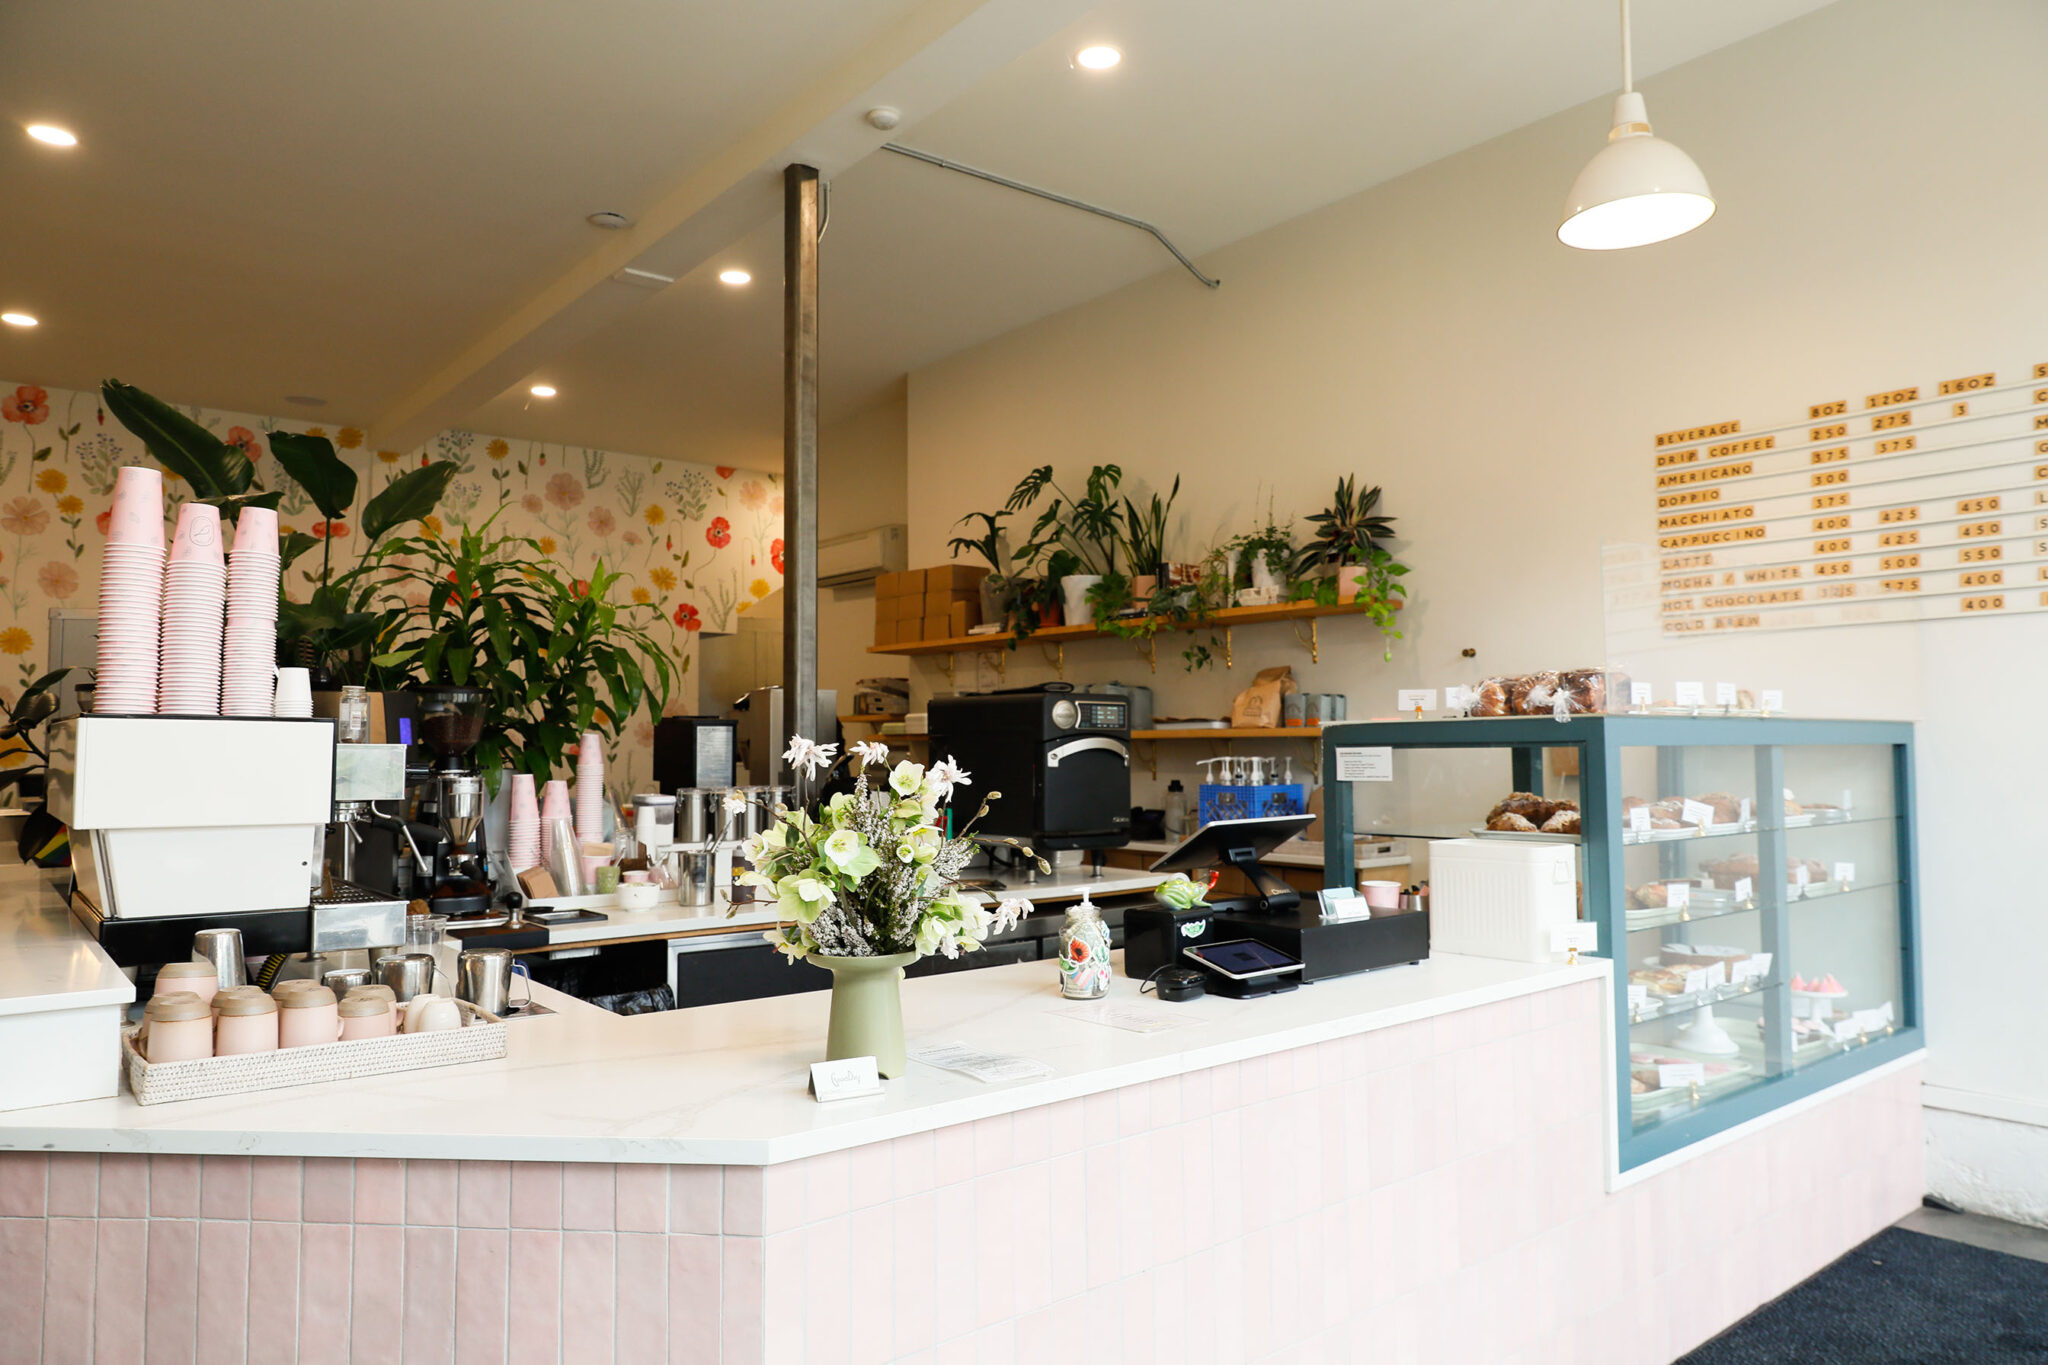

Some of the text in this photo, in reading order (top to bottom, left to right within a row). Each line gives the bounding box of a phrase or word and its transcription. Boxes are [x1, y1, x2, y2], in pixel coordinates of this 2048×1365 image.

[1657, 423, 1738, 446] BEVERAGE
[1870, 389, 1917, 407] 12OZ
[1943, 376, 1993, 394] 16OZ
[1657, 405, 1965, 466] DRIP COFFEE 250 275 3
[1659, 439, 1913, 486] AMERICANO 375 375
[1658, 472, 1847, 507] DOPPIO 300
[1659, 495, 1847, 527] MACCHIATO 375
[1660, 499, 1999, 548] CAPPUCCINO 400 425 450
[1662, 523, 1999, 569] LATTE 400 425 450
[1662, 575, 1712, 589] MOCHA
[1744, 568, 1800, 581] WHITE
[1818, 564, 1850, 575] 450
[1884, 556, 1917, 569] 500
[1964, 548, 2000, 561] 550
[1663, 600, 1692, 611] HOT
[1704, 592, 1801, 608] CHOCOLATE
[1884, 580, 1918, 592] 375
[1964, 573, 2001, 585] 400
[1664, 620, 1704, 631] COLD
[1716, 616, 1759, 628] BREW
[1966, 598, 2002, 610] 400
